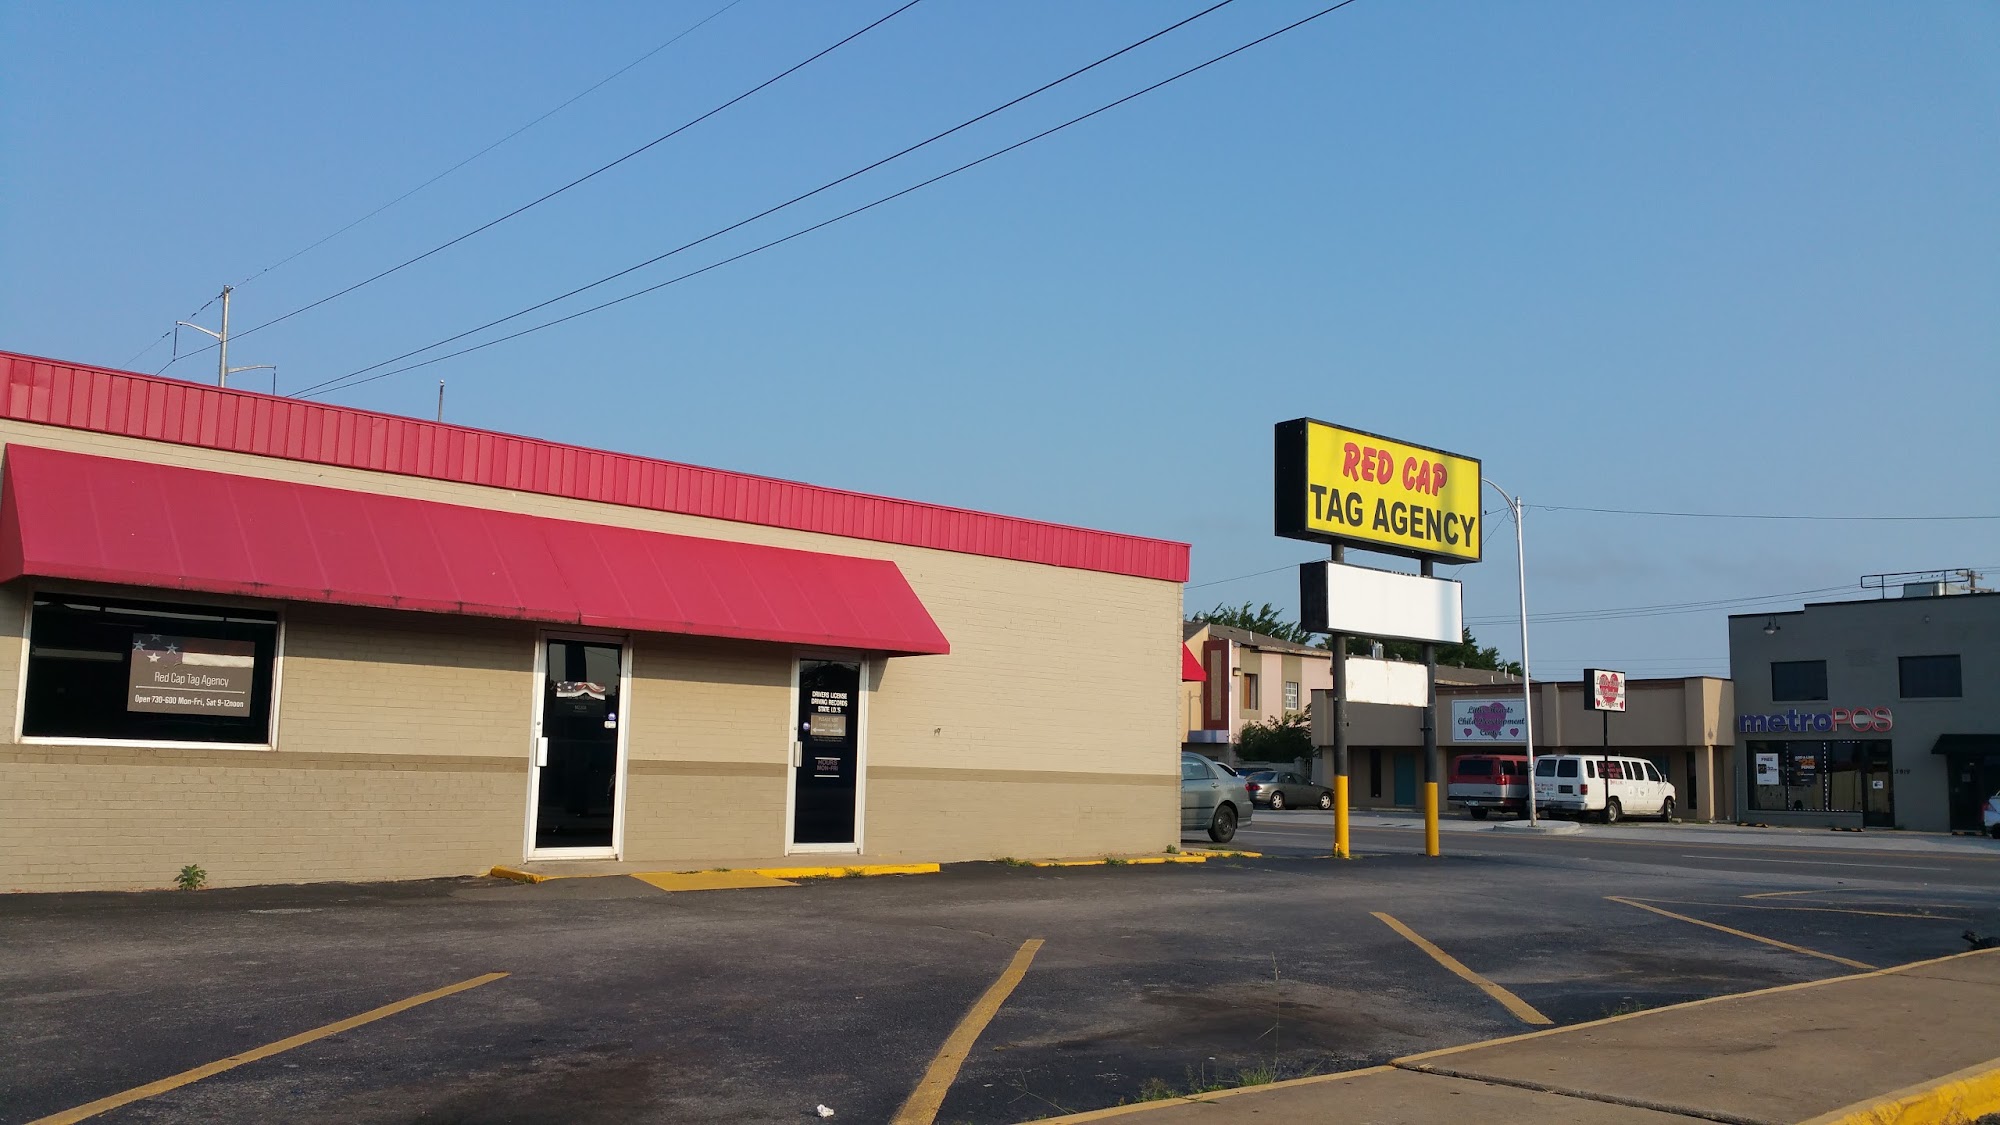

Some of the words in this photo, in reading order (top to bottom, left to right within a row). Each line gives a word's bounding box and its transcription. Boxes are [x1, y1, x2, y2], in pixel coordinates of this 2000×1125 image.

[1342, 442, 1394, 485] RED
[1402, 456, 1448, 497] CAP
[1310, 483, 1363, 527] TAG
[1372, 497, 1476, 548] AGENCY
[154, 671, 170, 683] Red
[171, 672, 186, 685] Cap
[187, 673, 200, 686] Tag
[201, 674, 230, 688] Agency
[134, 694, 151, 704] Open
[151, 696, 177, 704] 730-600
[205, 698, 217, 707] Sat
[811, 690, 830, 699] DRIVERS
[830, 692, 848, 700] LICENSE
[811, 698, 828, 706] DRIVING
[828, 699, 848, 707] RECORDS
[1467, 705, 1486, 714] Little
[1489, 704, 1514, 714] Hearts
[1457, 717, 1476, 726] Child
[1479, 717, 1525, 727] Development
[1738, 706, 1893, 733] metroPCS
[1480, 729, 1503, 737] Center
